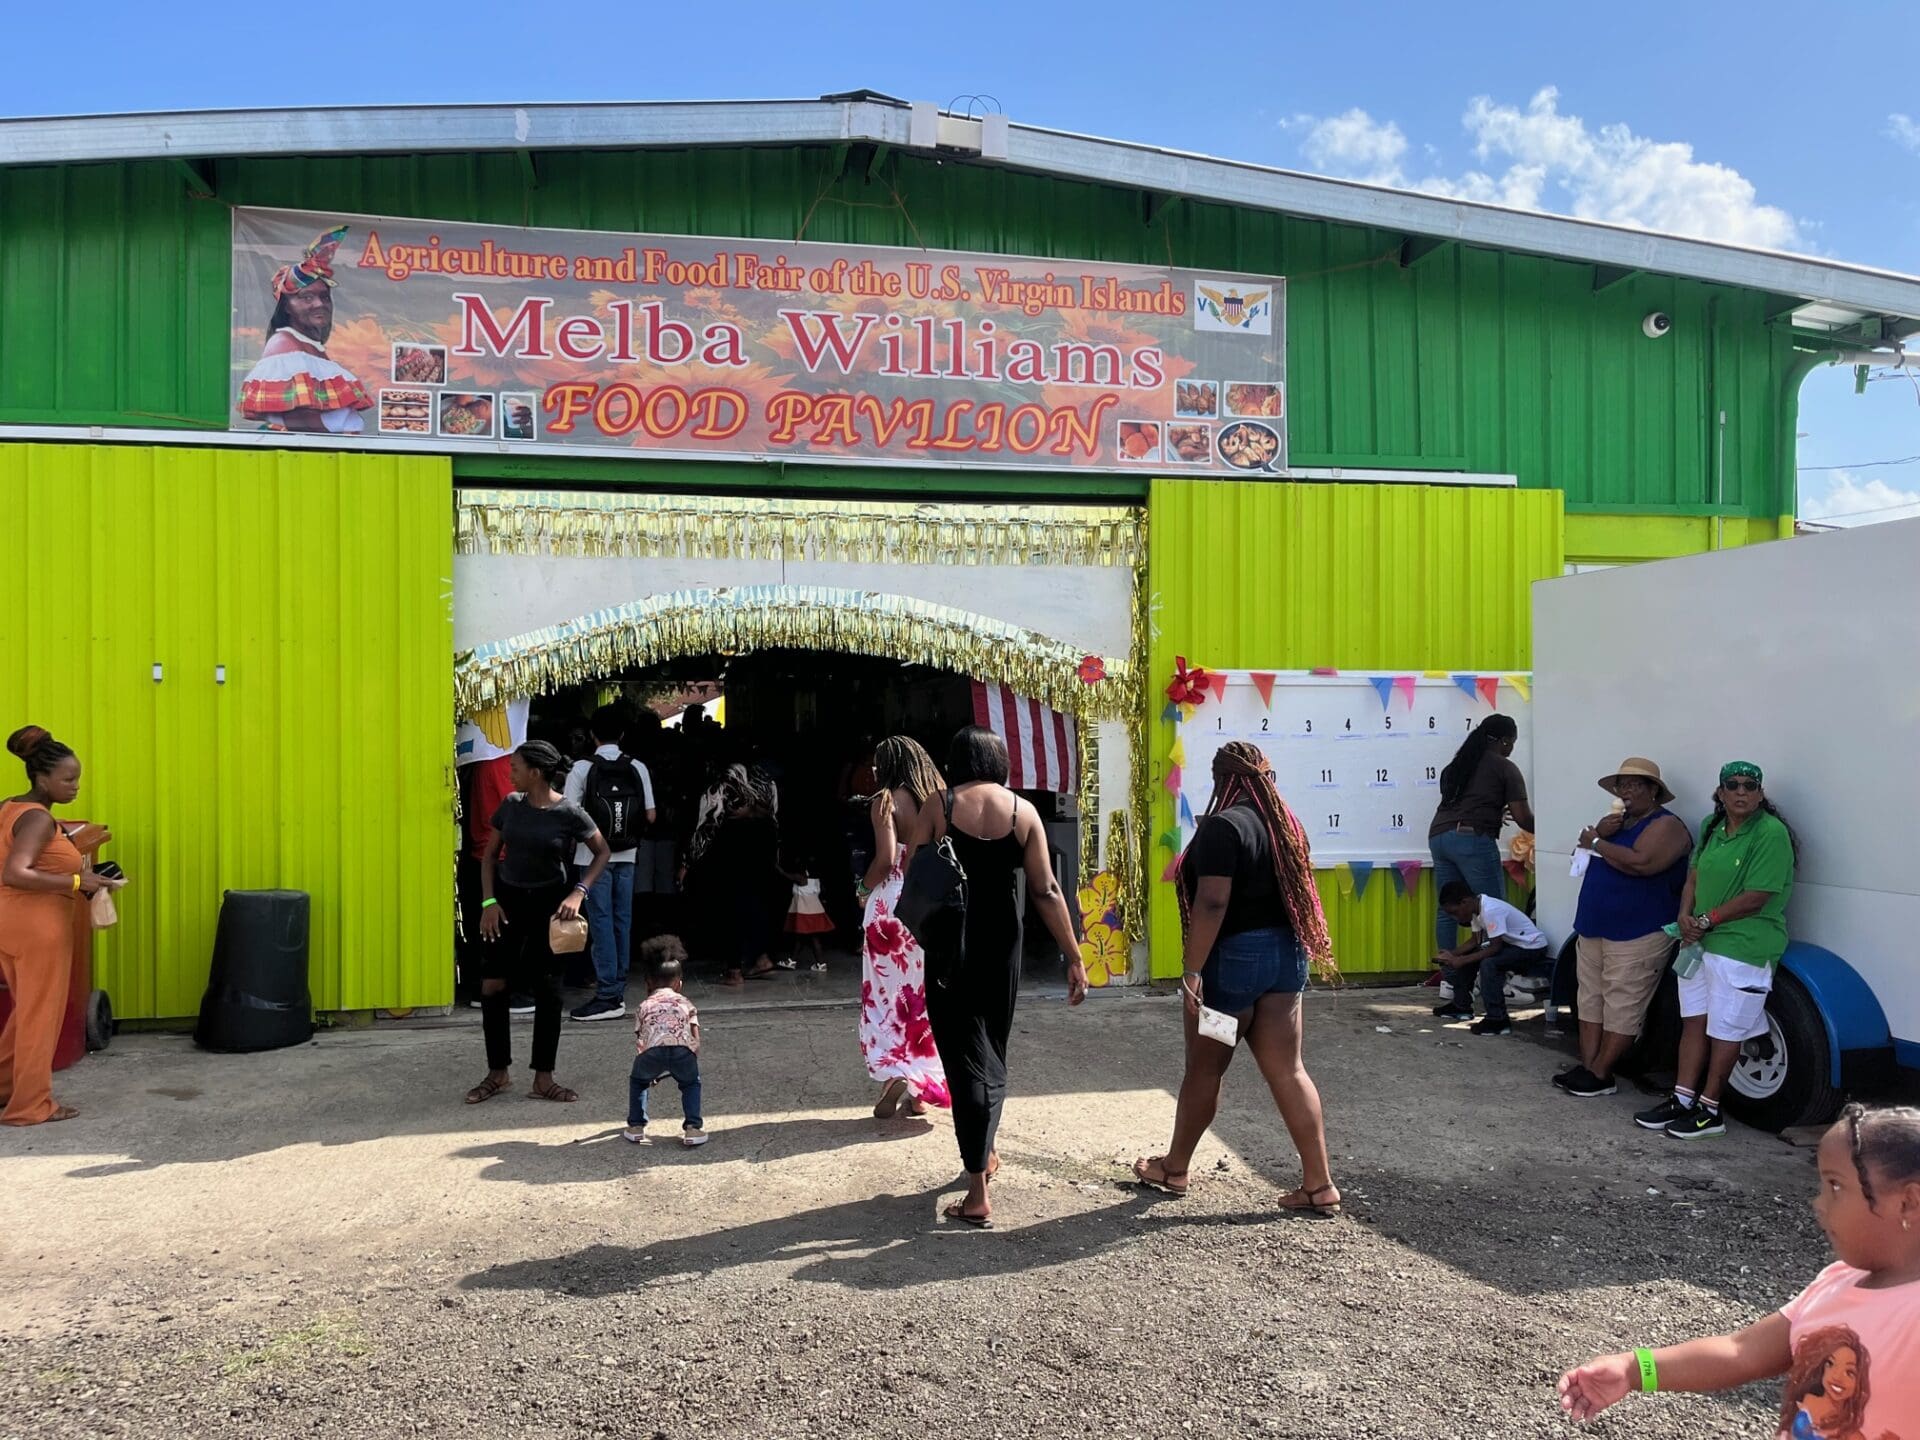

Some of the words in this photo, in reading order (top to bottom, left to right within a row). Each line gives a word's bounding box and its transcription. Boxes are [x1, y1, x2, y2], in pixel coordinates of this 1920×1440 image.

[360, 231, 567, 280] Agriculture
[575, 249, 636, 282] and
[642, 249, 731, 287] Food
[735, 253, 803, 291] Fair
[810, 259, 848, 294] of
[849, 259, 902, 297] the
[906, 263, 970, 301] U.S.
[976, 268, 1077, 315] Virgin
[1079, 276, 1186, 316] Islands
[452, 292, 749, 368] Melba
[777, 309, 1166, 389] Williams
[543, 381, 750, 440] FOOD
[768, 392, 1120, 457] PAVILION
[1217, 717, 1222, 730] 1
[1262, 718, 1268, 731] 2
[1305, 720, 1312, 732] 3
[1345, 718, 1351, 731] 4
[1385, 716, 1392, 729] 5
[1429, 717, 1435, 729] 6
[1466, 718, 1472, 731] 7
[1321, 770, 1332, 783] 11
[1376, 769, 1388, 783] 12
[1425, 767, 1436, 780] 13
[614, 801, 623, 833] Reebok
[1328, 814, 1340, 828] 17
[1391, 814, 1403, 827] 18
